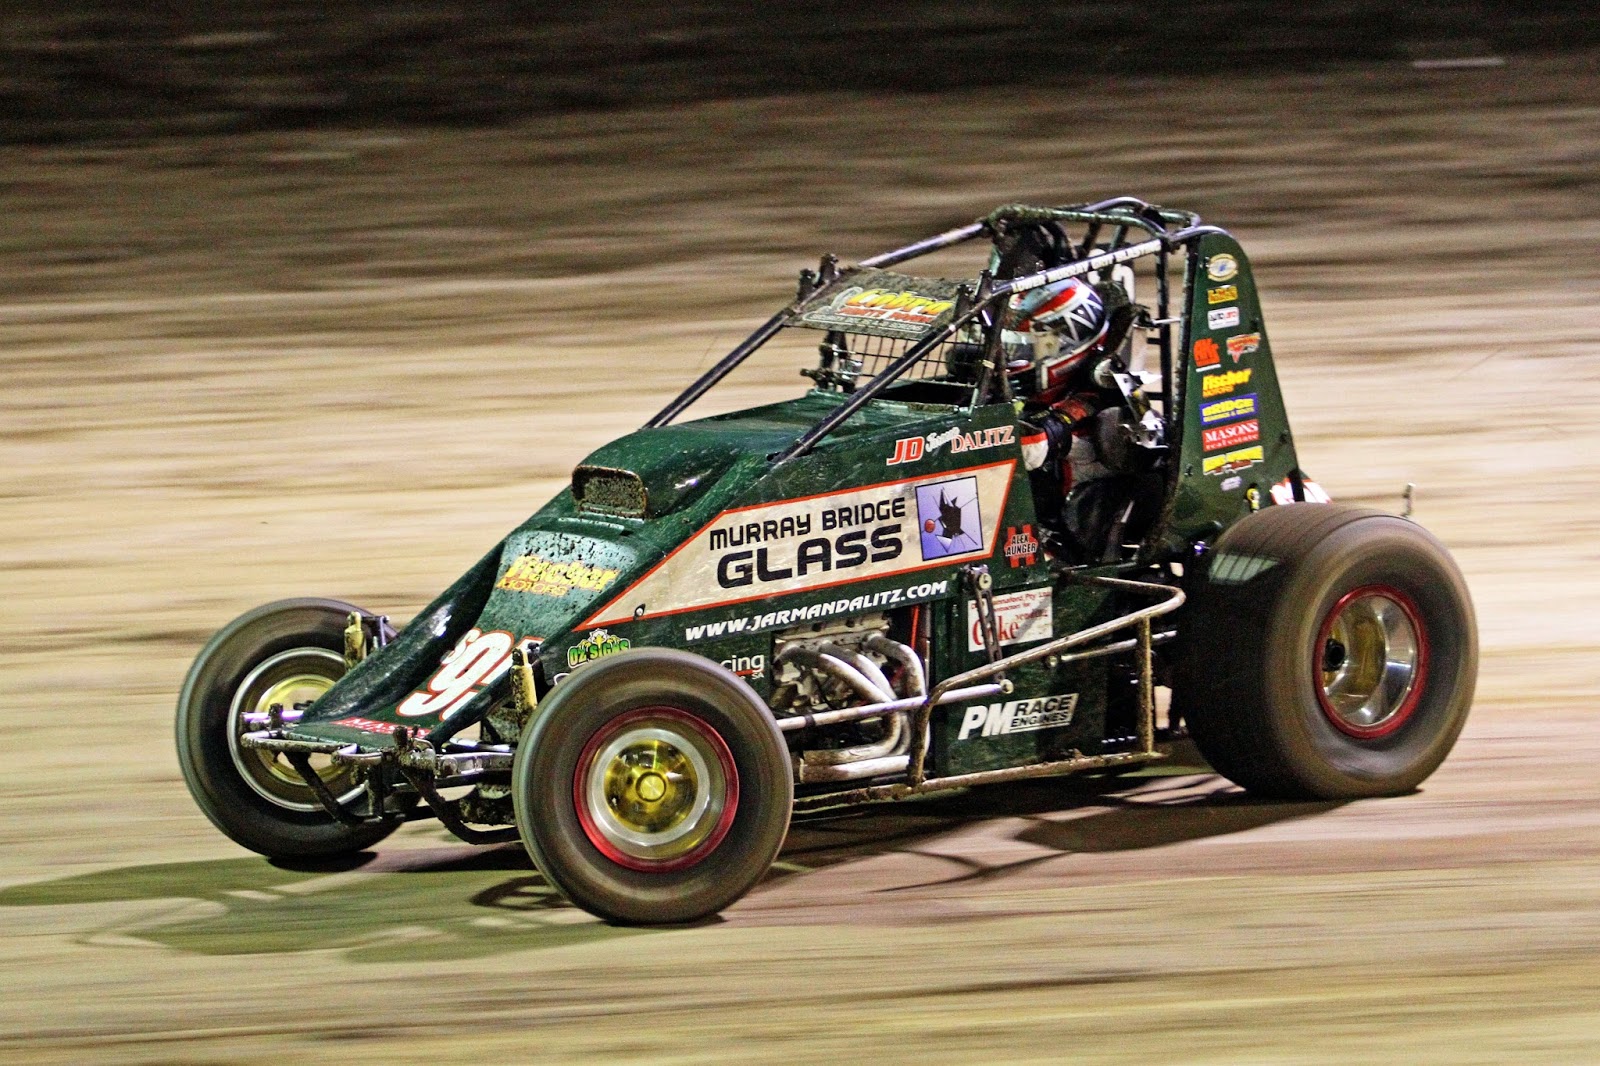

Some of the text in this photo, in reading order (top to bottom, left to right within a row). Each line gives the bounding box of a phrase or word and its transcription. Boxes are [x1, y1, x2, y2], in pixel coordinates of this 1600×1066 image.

[886, 436, 925, 465] JD
[951, 425, 1015, 453] DALITZ
[1204, 421, 1259, 442] MASONS
[710, 497, 906, 550] MURRAY BRIDGE
[1005, 543, 1037, 556] AUNGER
[1011, 534, 1029, 544] ALEX
[717, 524, 903, 588] GLASS
[685, 580, 948, 641] WWW.JARMANDALITZ.COM
[720, 654, 765, 673] cing
[957, 696, 1073, 740] PM RACE
[1011, 712, 1068, 728] ENGINES
